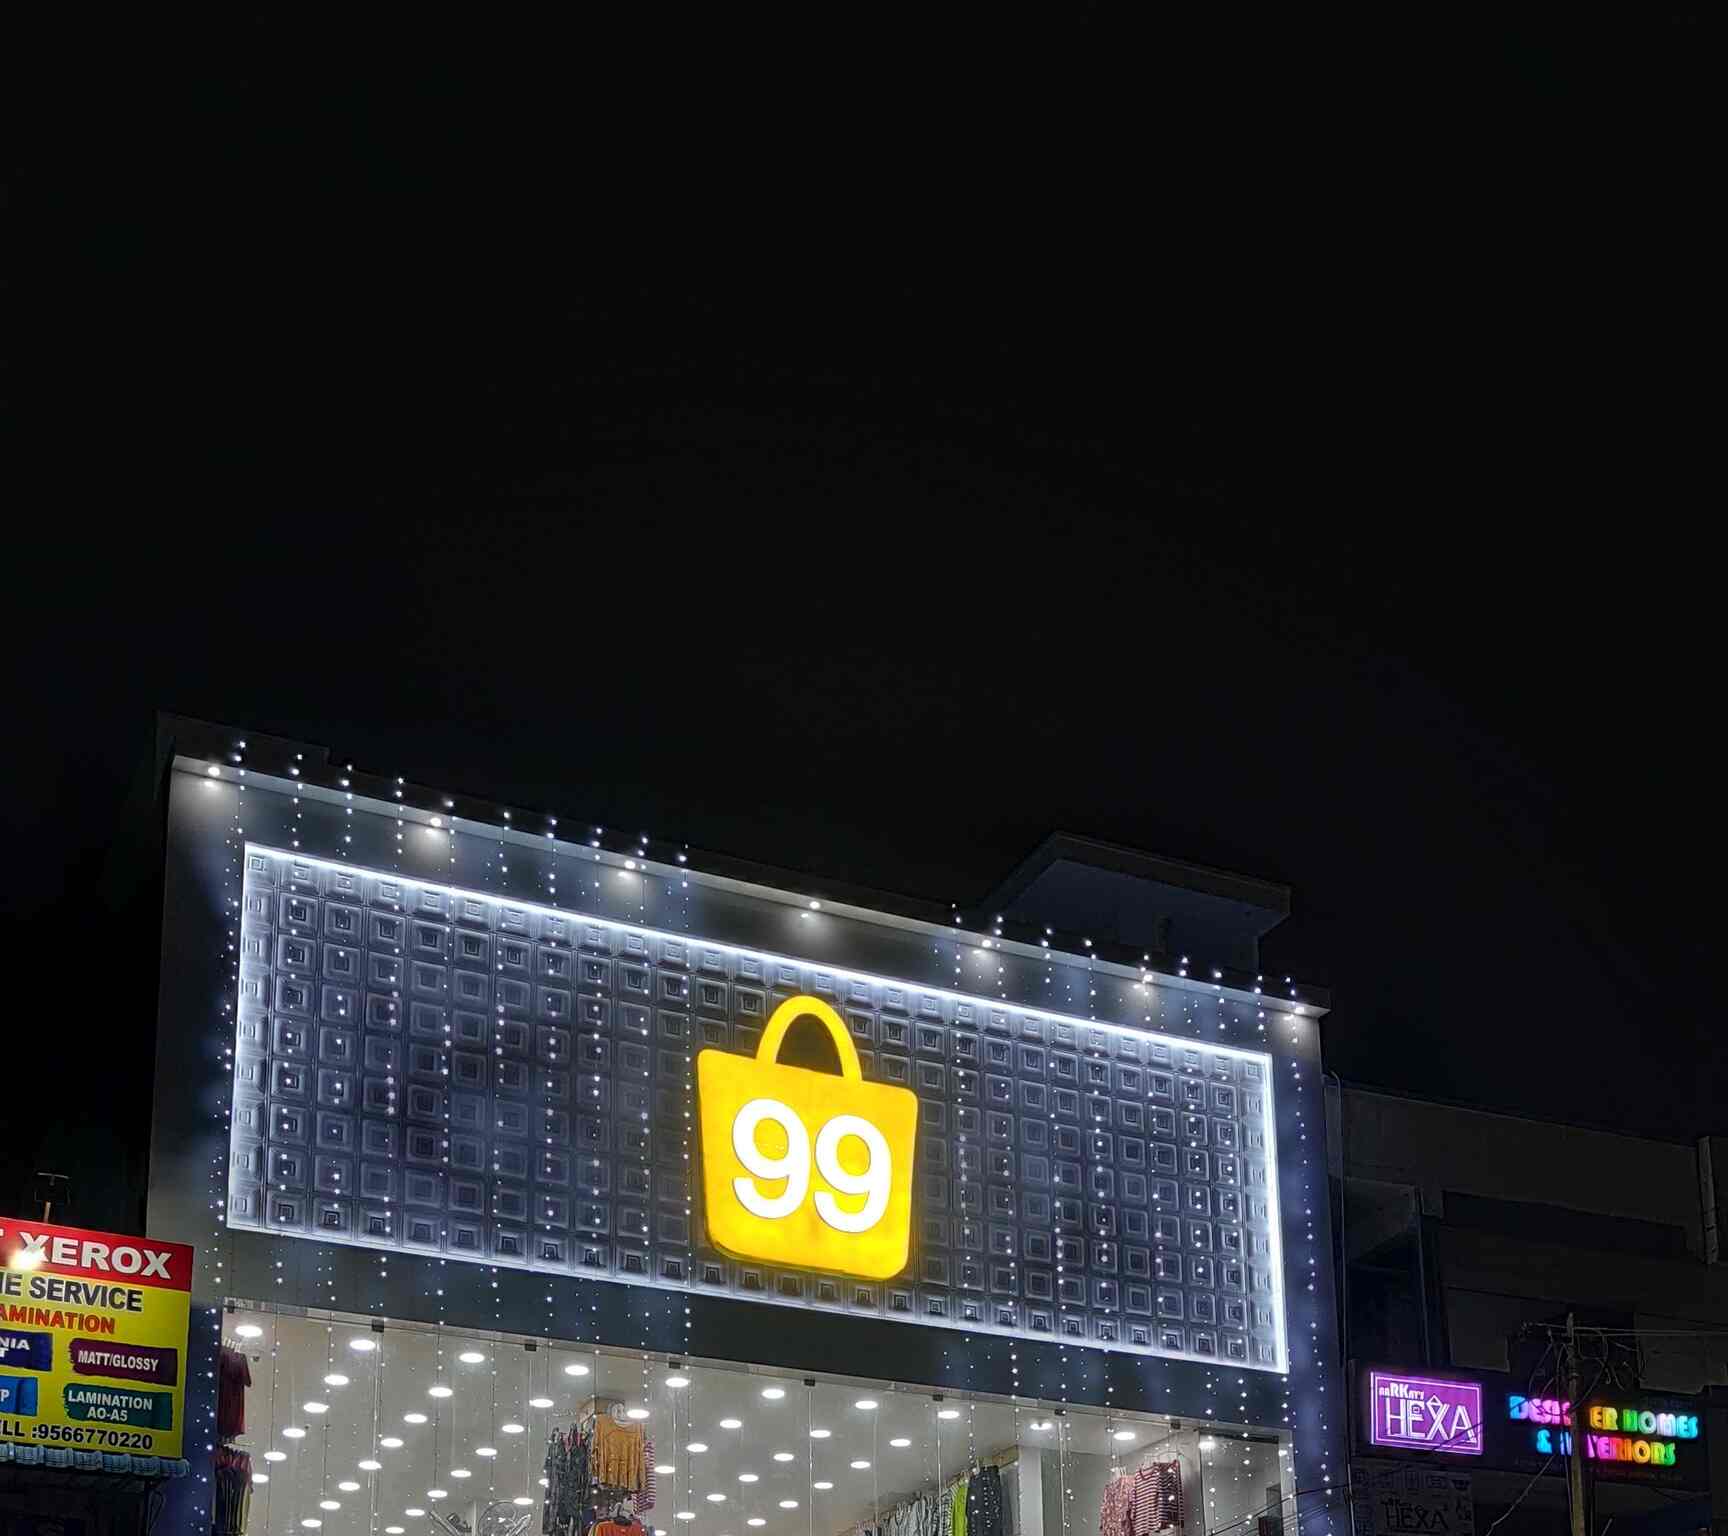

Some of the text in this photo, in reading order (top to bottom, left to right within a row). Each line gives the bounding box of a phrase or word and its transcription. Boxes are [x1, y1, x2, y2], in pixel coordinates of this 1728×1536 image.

[731, 1096, 893, 1234] 99
[19, 1231, 171, 1280] XEROX
[29, 1275, 143, 1312] SERVICE
[78, 1350, 159, 1372] MATT/GLOSSY
[68, 1389, 153, 1410] LAMINATION
[1385, 1393, 1478, 1443] HEXA
[1622, 1409, 1698, 1439] HOMES
